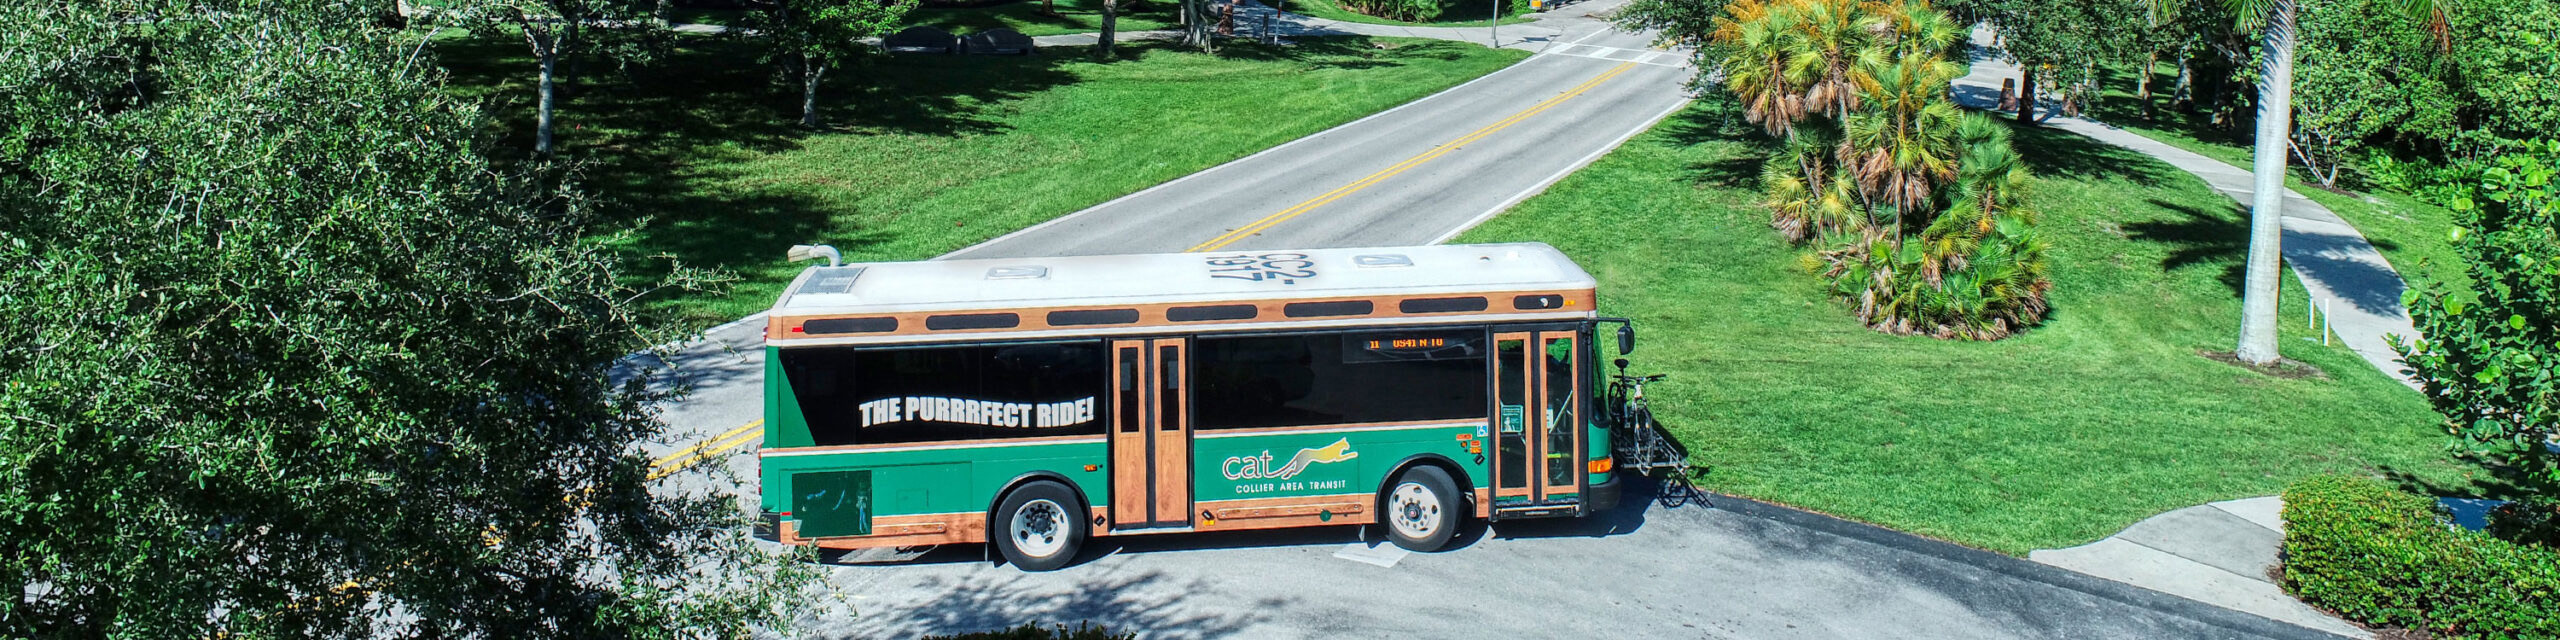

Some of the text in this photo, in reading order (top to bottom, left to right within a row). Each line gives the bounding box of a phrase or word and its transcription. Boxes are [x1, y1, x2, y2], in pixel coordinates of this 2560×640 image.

[1419, 338, 1428, 347] N
[859, 396, 1094, 428] THE PURRRFECT RIDE!
[1222, 449, 1276, 480] cat
[1236, 480, 1346, 493] COLLIER AREA TRANSIT
